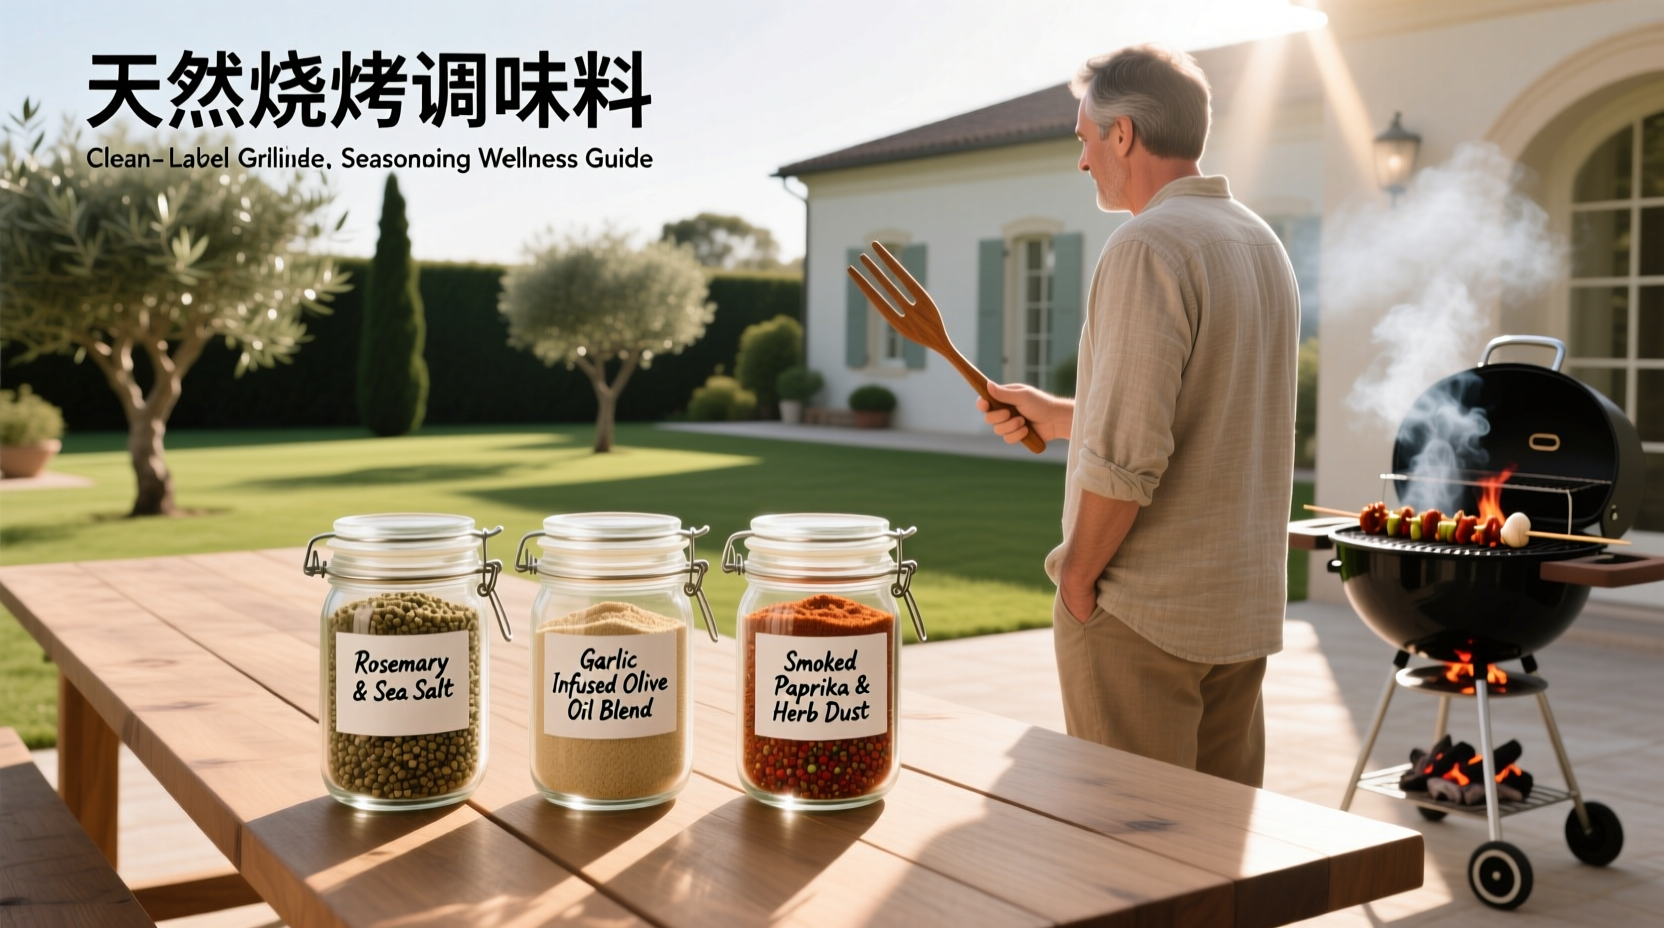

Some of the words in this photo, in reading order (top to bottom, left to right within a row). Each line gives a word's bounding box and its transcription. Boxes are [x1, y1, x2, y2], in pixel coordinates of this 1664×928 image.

[354, 649, 449, 679] Rosemary
[580, 647, 638, 671] Garlic
[783, 649, 858, 673] Smoked
[353, 680, 368, 702] &
[373, 680, 409, 702] Sea
[413, 677, 455, 701] Salt
[552, 671, 618, 699] Infused
[622, 670, 669, 694] Olive
[774, 674, 850, 704] Paprika
[855, 674, 870, 695] &
[567, 698, 594, 721] Oil
[599, 696, 654, 721] Blend
[773, 701, 819, 723] Herb
[824, 701, 870, 723] Dust
